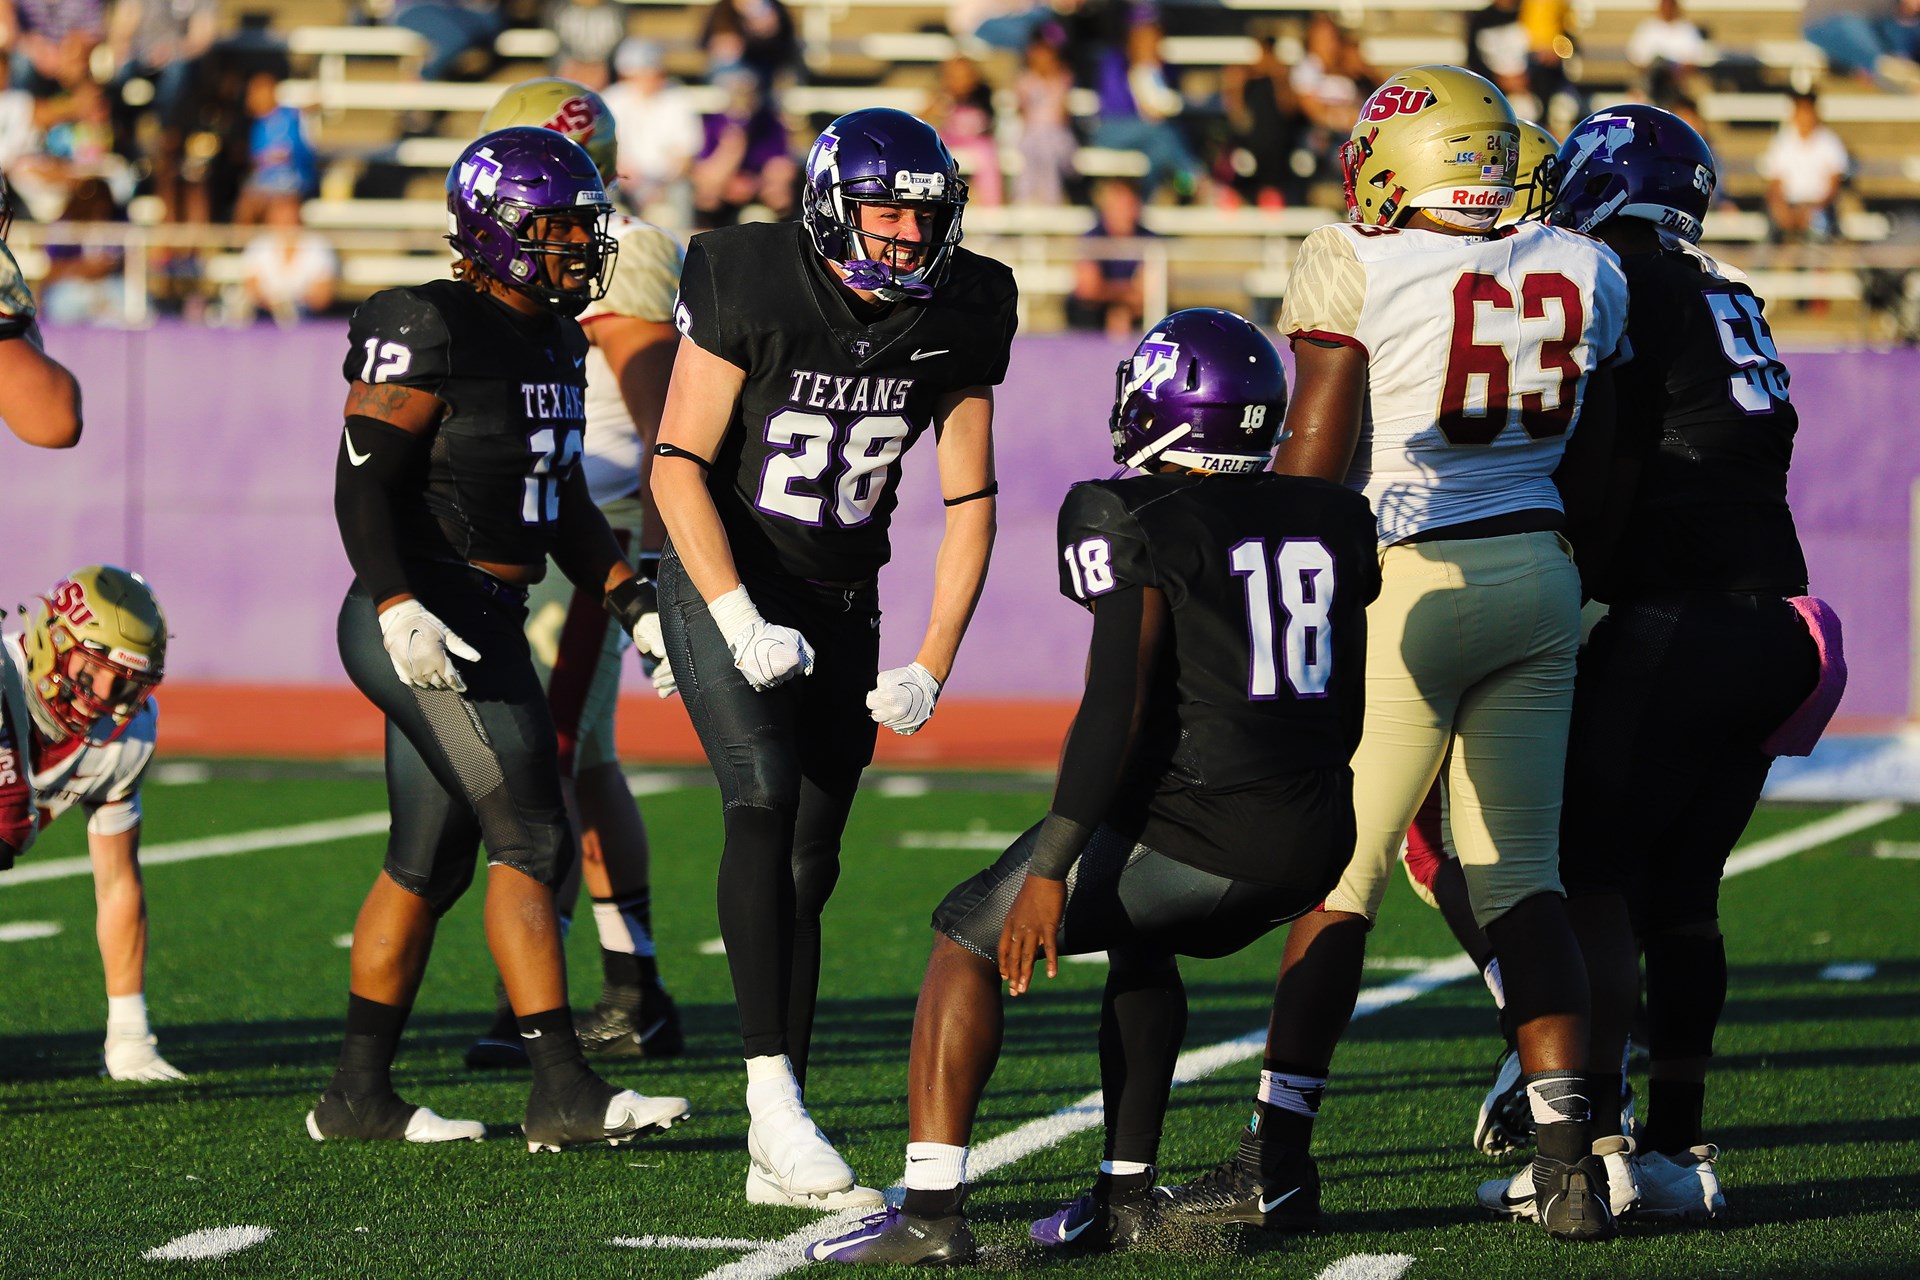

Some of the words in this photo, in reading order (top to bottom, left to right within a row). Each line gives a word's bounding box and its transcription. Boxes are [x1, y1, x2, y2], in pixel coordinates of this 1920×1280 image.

[1487, 134, 1502, 151] 24
[1452, 189, 1514, 206] Riddell
[1692, 163, 1713, 196] 55
[363, 336, 413, 384] 12
[1436, 269, 1586, 447] 63
[1701, 289, 1791, 415] 55
[790, 369, 915, 411] TEXANS
[1239, 404, 1267, 429] 18
[755, 406, 913, 528] 28
[1064, 536, 1117, 599] 18
[1228, 537, 1337, 700] 18
